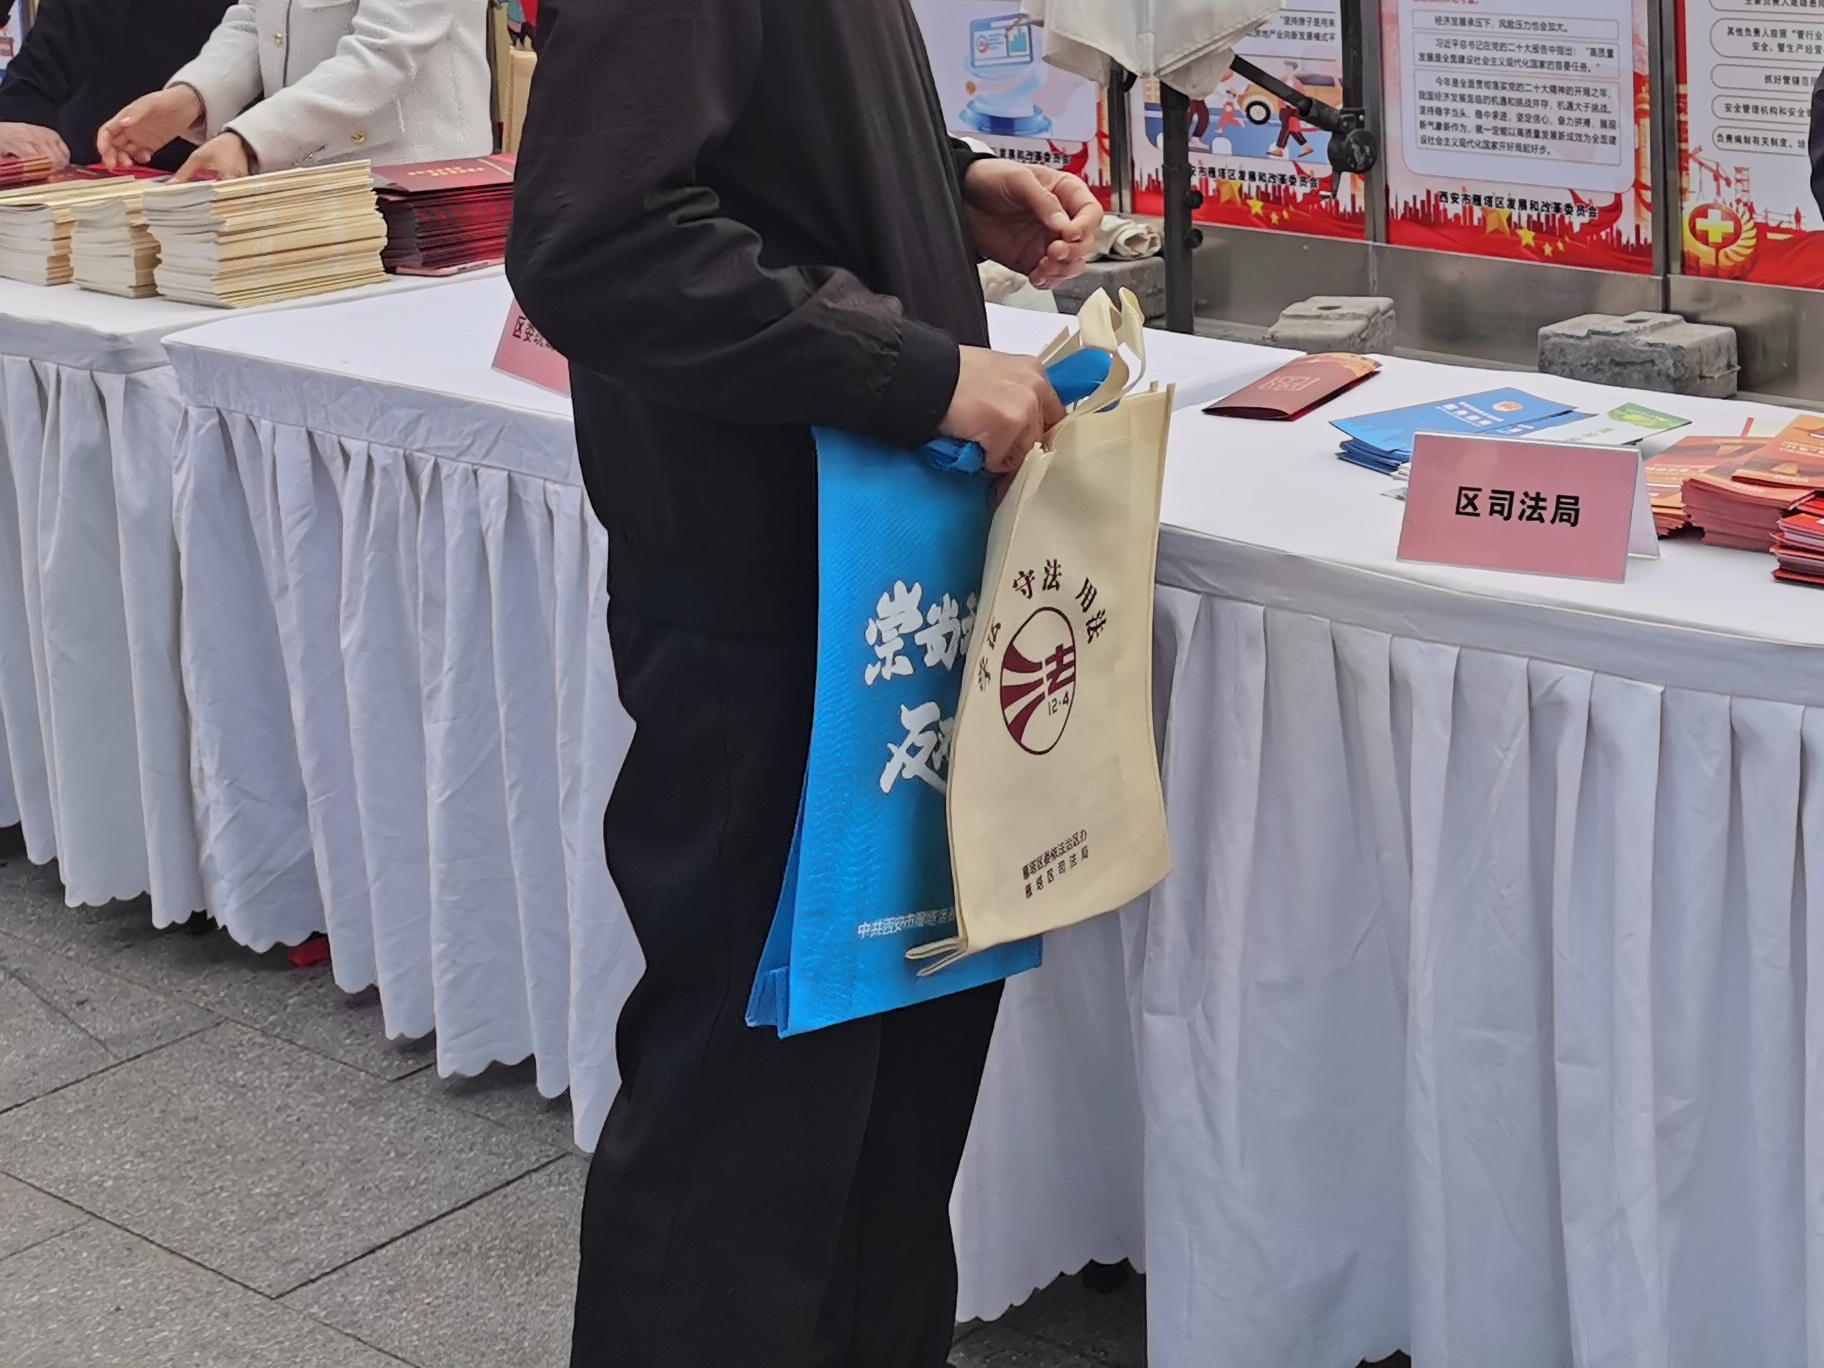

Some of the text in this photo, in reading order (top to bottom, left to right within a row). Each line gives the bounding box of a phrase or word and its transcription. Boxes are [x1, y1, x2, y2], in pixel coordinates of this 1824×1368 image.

[992, 147, 1071, 165] 发展和改革委员会
[1438, 190, 1598, 218] 西安市雁塔区发展和改革委员会
[1454, 484, 1582, 528] 区司法局
[1012, 558, 1107, 645] 守法 用法
